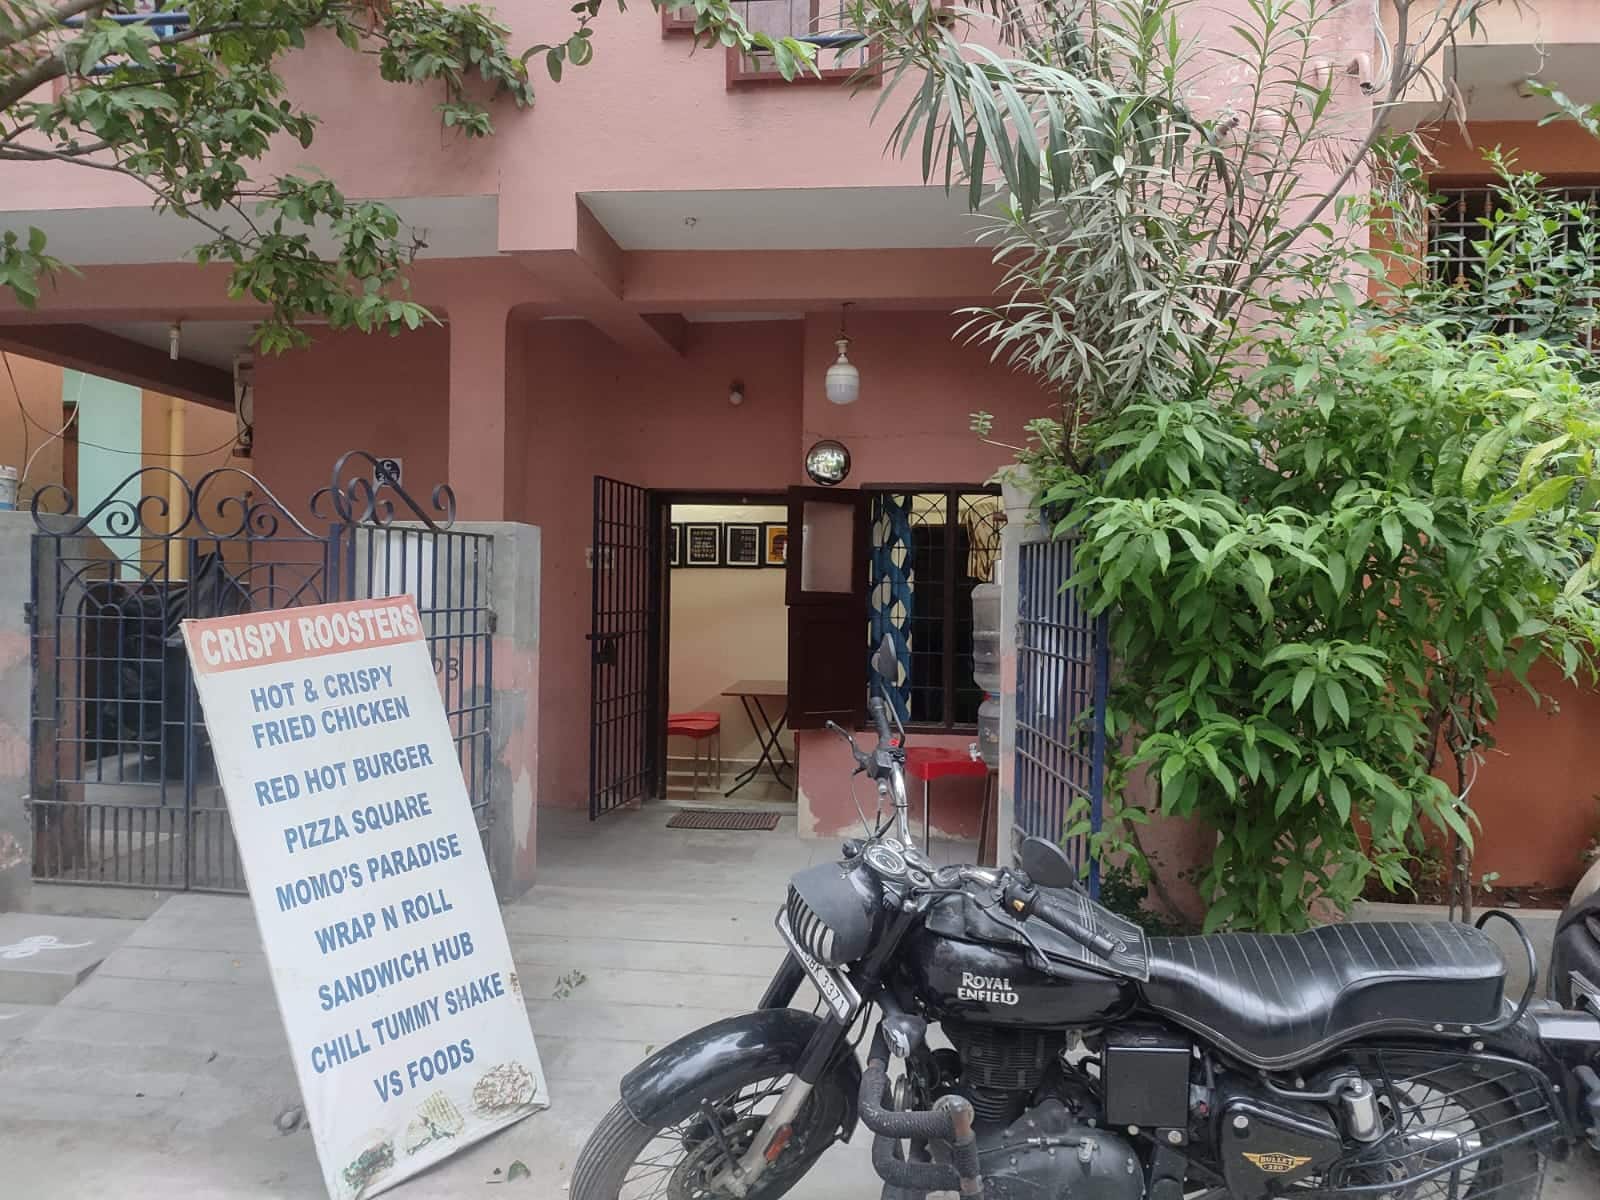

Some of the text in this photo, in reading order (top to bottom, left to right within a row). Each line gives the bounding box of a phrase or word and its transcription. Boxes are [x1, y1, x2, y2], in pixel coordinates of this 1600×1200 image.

[200, 604, 419, 665] CRISPY ROOSTERS
[250, 665, 393, 713] HOT & CRISPY
[251, 696, 410, 749] FRIED CHICKEN
[254, 743, 433, 807] RED HOT BURGER
[284, 792, 433, 854] PIZZA SQUARE
[275, 833, 463, 912] MOMO'S PARADISE
[314, 888, 454, 955] WRAP N ROLL
[318, 931, 475, 1012] SANDWICH HUB
[957, 987, 1019, 1005] ENFIELD
[962, 972, 1012, 991] ROYAL
[311, 972, 505, 1074] CHILL TUMMY SHAKE
[373, 1038, 475, 1103] VS FOODS
